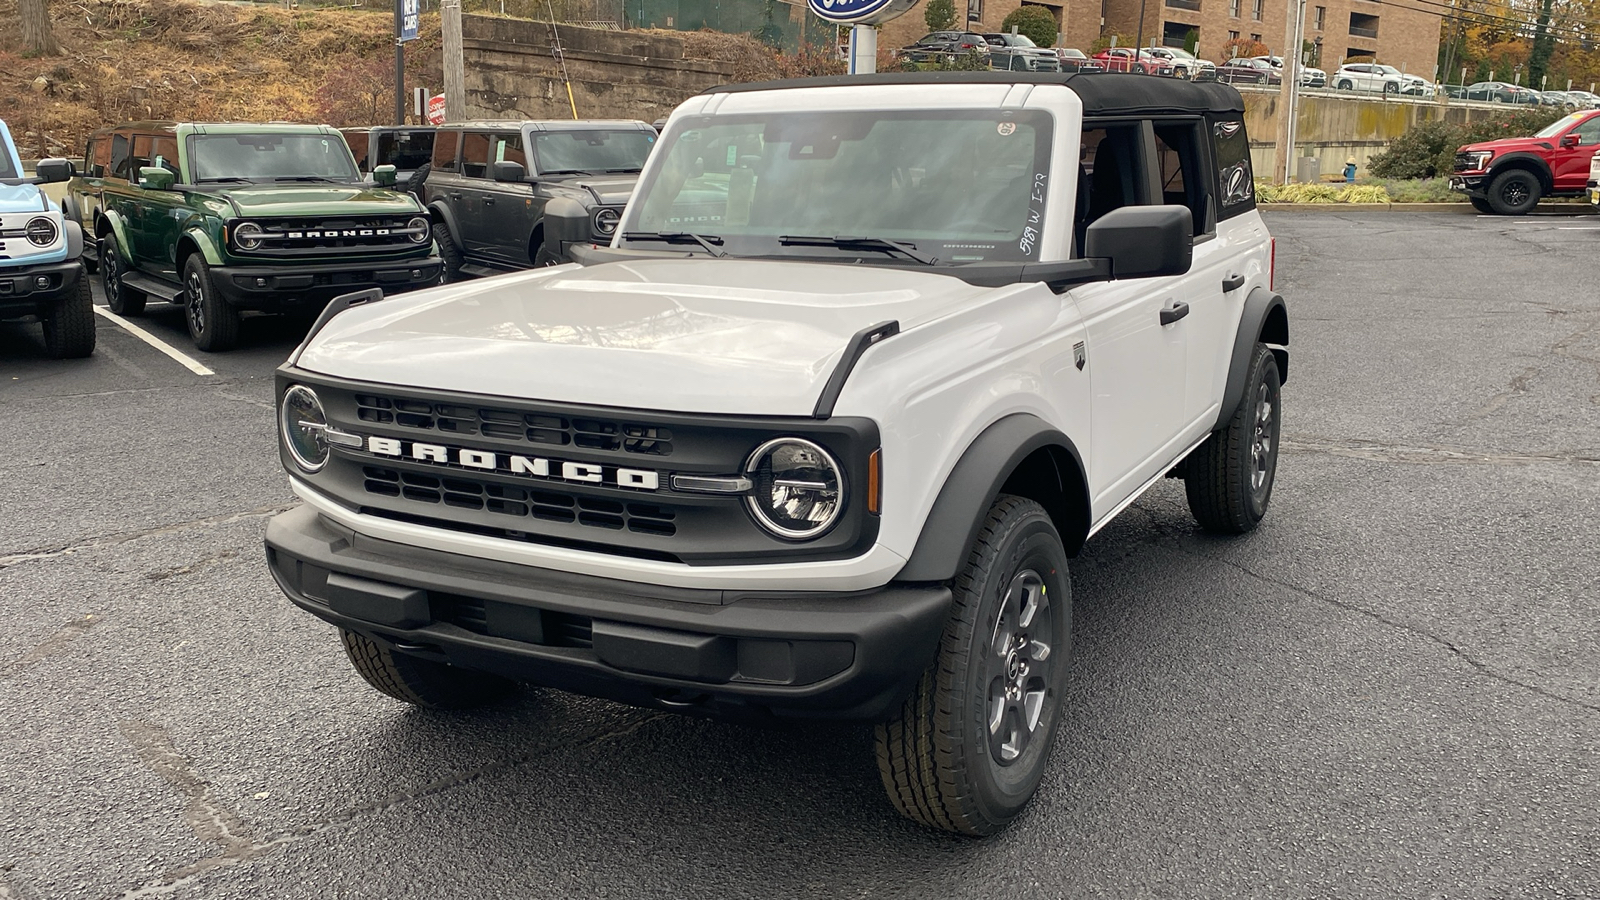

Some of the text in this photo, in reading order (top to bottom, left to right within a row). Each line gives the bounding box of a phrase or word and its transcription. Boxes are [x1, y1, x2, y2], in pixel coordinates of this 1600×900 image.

[404, 14, 417, 30] CARS
[288, 229, 390, 239] BRONCO
[368, 436, 659, 490] BRONCO
